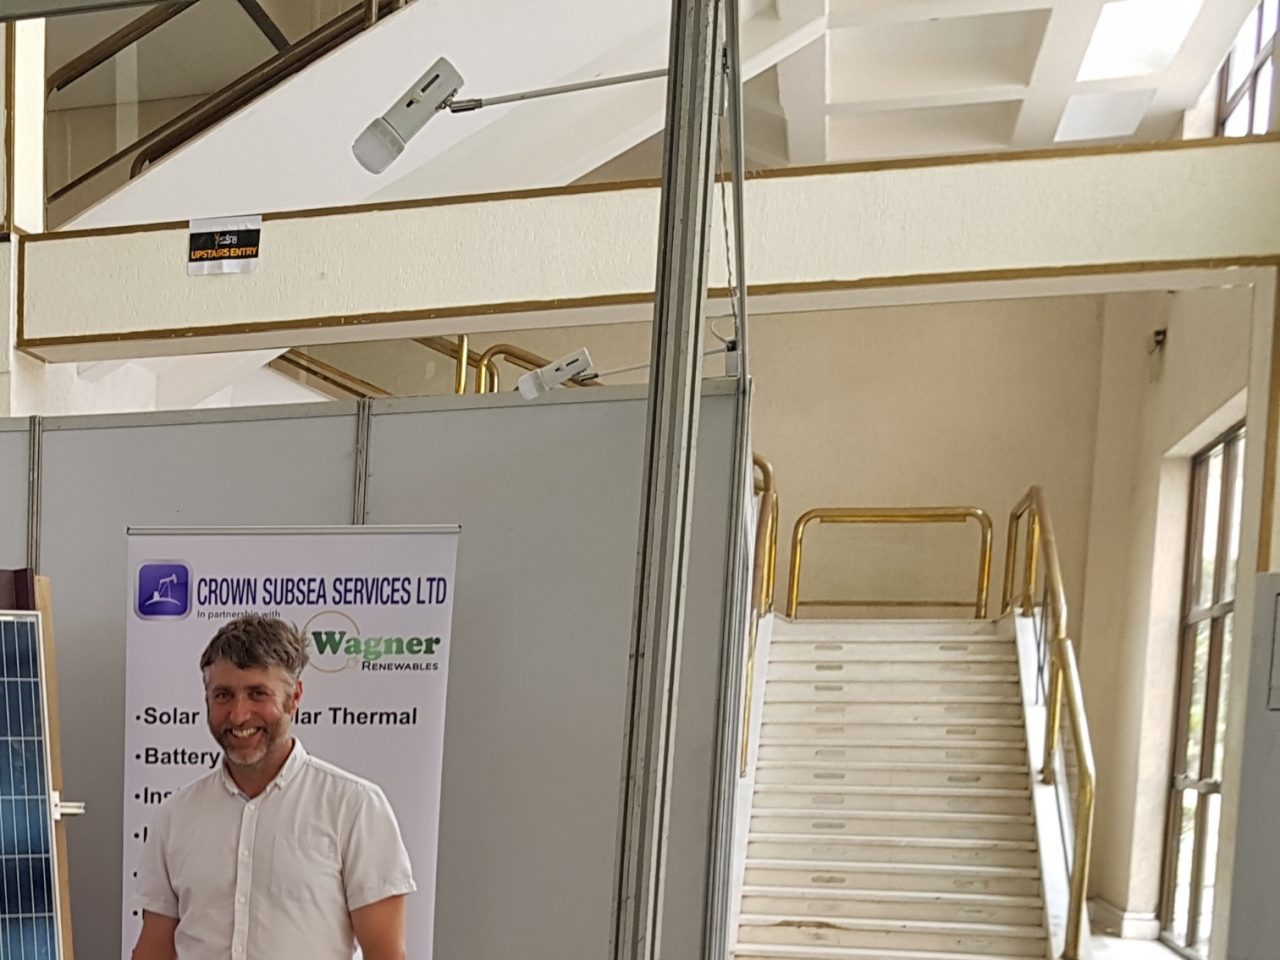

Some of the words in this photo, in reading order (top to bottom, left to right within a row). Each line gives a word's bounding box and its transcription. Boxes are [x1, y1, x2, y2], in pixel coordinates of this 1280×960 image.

[191, 249, 229, 259] UPSTAIRS
[231, 247, 257, 256] ENTRY
[197, 577, 257, 606] CROWN
[262, 577, 326, 606] SUBSEA
[332, 577, 411, 606] SERVICES
[417, 577, 447, 605] LTD
[197, 609, 205, 618] In
[208, 609, 259, 620] partnership
[261, 609, 280, 618] with
[311, 631, 441, 661] Wagner
[362, 661, 439, 671] RENEWABLES
[143, 707, 200, 725] Solar
[292, 707, 322, 725] lar
[329, 707, 417, 725] Thermal
[144, 748, 220, 768] Battery
